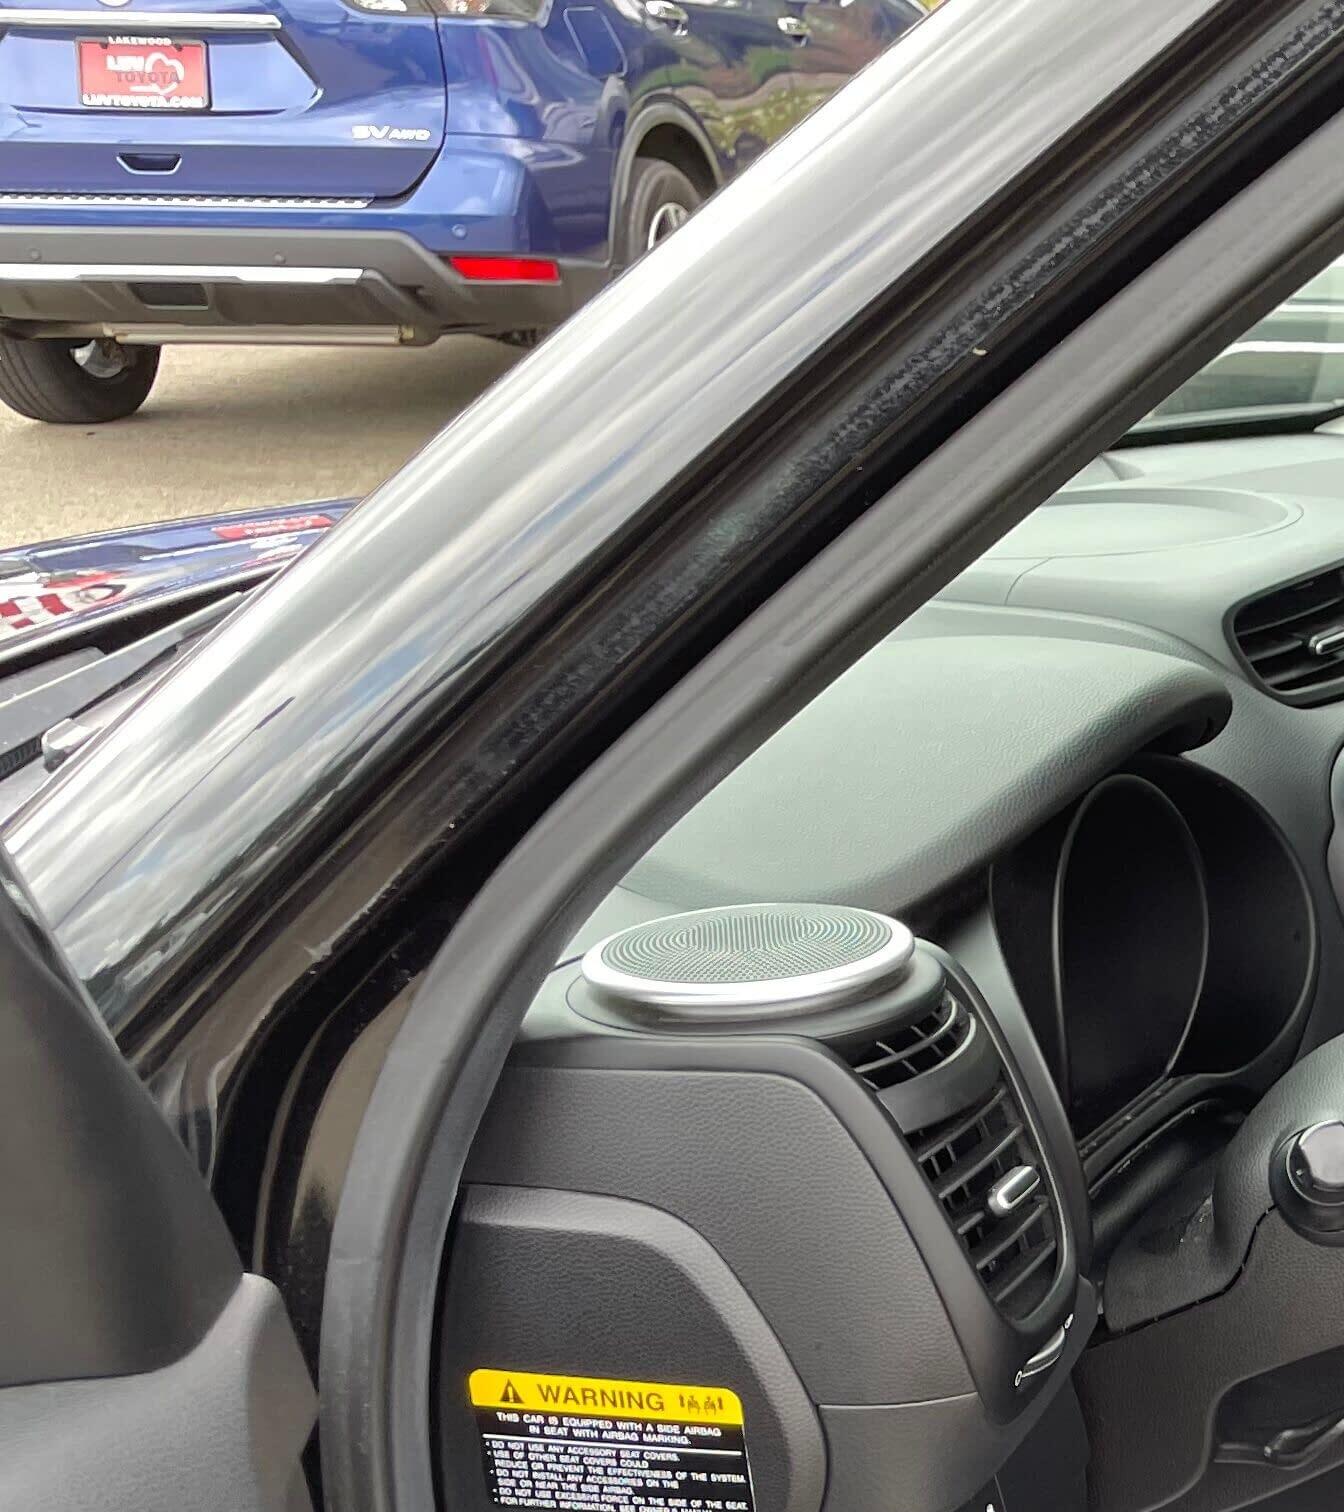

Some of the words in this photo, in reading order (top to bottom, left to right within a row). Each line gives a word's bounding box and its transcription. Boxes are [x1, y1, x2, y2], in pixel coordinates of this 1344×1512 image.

[116, 71, 180, 83] TOYOTA
[351, 125, 390, 139] SV
[536, 1382, 664, 1411] WARNING
[496, 1411, 519, 1422] THIS
[523, 1413, 544, 1424] CAR
[548, 1415, 558, 1425] IS
[562, 1416, 612, 1429] EQUIPPED
[616, 1420, 642, 1431] WITH
[646, 1422, 653, 1432] A
[657, 1423, 680, 1434] SIDE
[684, 1424, 721, 1437] AIRBAG
[529, 1424, 539, 1434] IN
[543, 1425, 568, 1436] SEAT
[572, 1427, 598, 1438] WITH
[602, 1429, 638, 1441] AIRBAG
[642, 1432, 692, 1445] MARKING.
[491, 1440, 504, 1449] DO
[507, 1441, 524, 1450] NOT
[547, 1444, 564, 1453] ANY
[567, 1445, 616, 1457] ACCESSORY
[527, 1452, 556, 1462] OTHER
[619, 1458, 648, 1468] COULD
[546, 1462, 584, 1473] PREVENT
